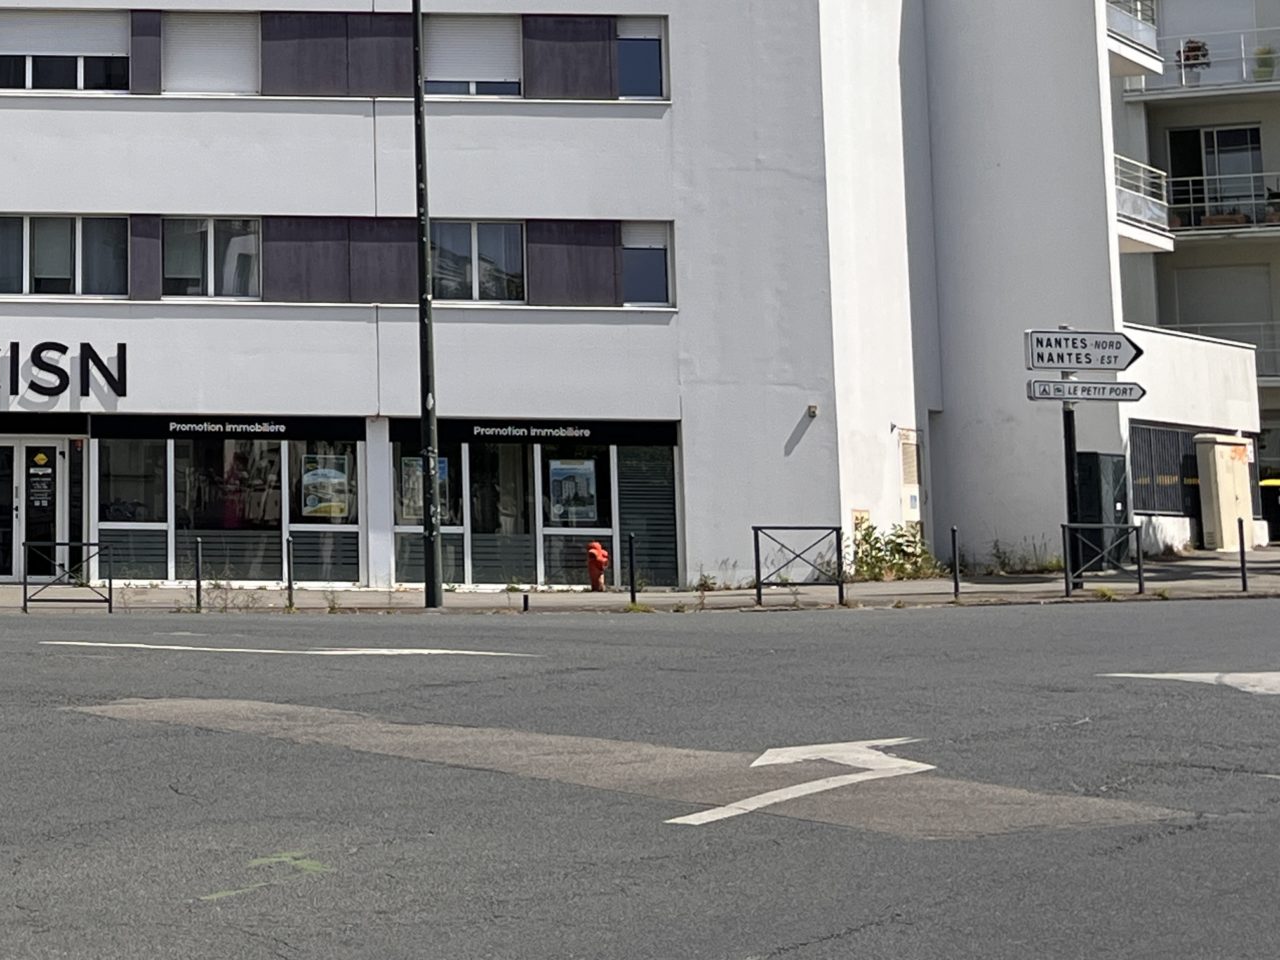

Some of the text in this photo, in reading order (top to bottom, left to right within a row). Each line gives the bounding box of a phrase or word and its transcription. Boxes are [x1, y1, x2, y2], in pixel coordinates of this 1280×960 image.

[1036, 337, 1088, 349] NANTES
[1037, 352, 1092, 364] NANTES
[1068, 386, 1134, 397] LE PETIT PORT
[169, 422, 223, 432] Promotion
[473, 426, 527, 436] Promotion
